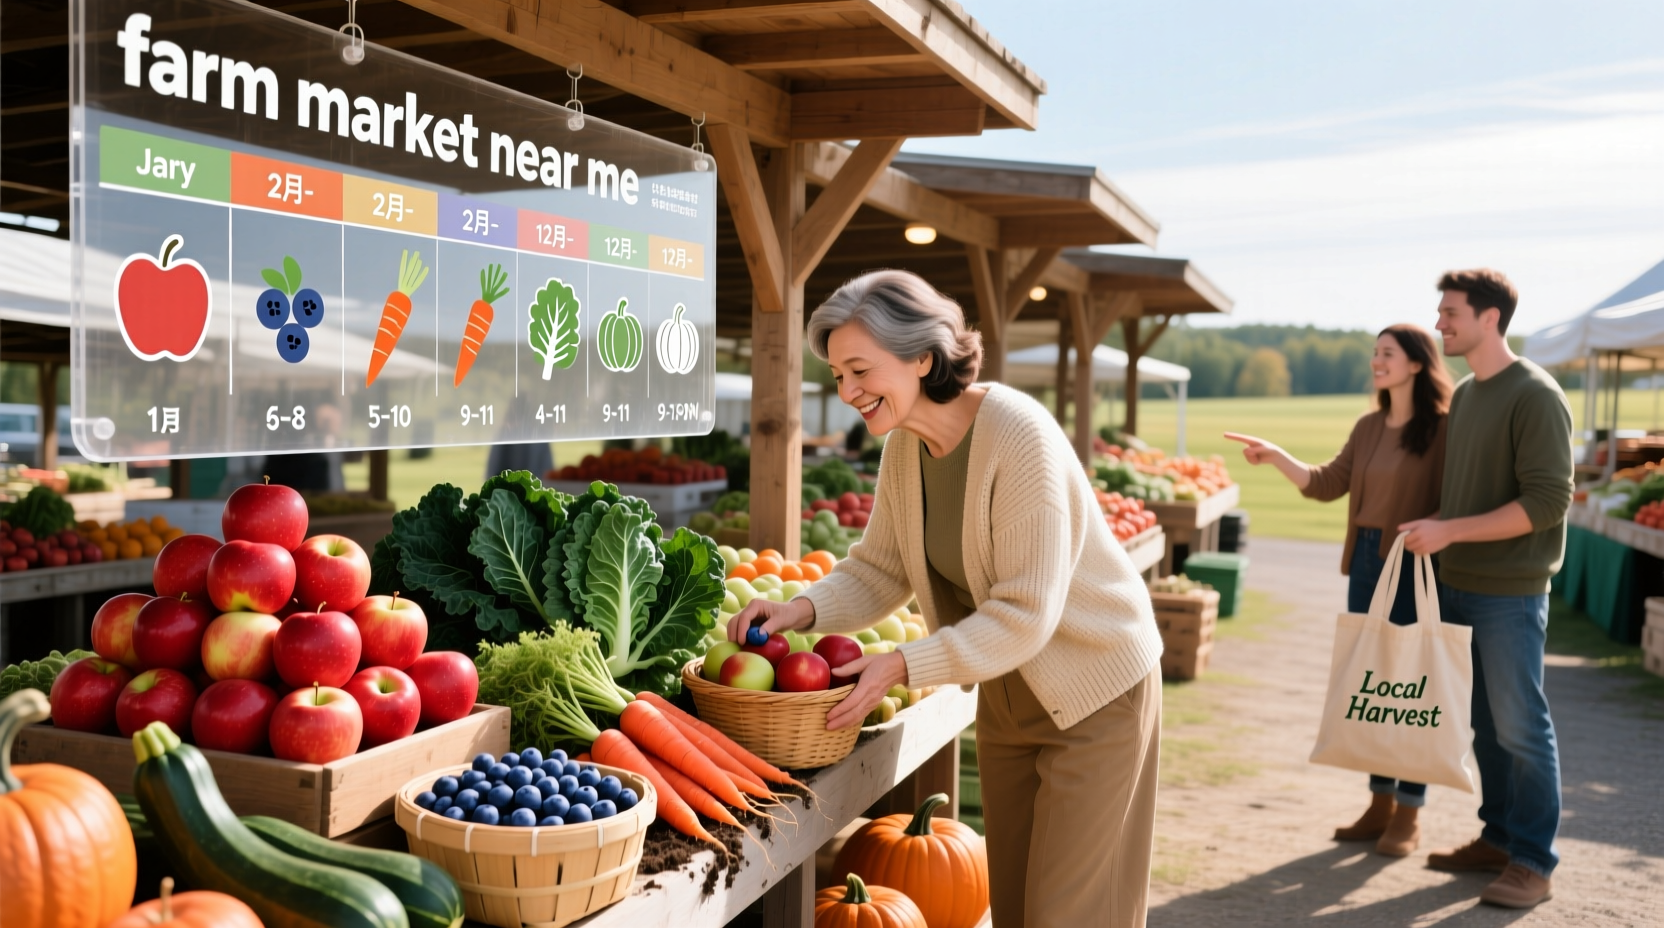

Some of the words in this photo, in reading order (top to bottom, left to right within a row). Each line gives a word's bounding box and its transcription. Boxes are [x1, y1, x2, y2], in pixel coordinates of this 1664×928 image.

[117, 13, 279, 120] farm
[298, 79, 479, 168] market
[490, 132, 579, 192] near
[587, 158, 640, 206] me
[135, 148, 196, 189] Jary
[266, 172, 314, 205] 2月-
[372, 192, 414, 222] 2月-
[462, 208, 499, 236] 2月-
[536, 223, 574, 249] 12月-
[604, 237, 638, 260] 12月-
[662, 247, 693, 269] 12月-
[147, 406, 180, 434] 1月
[266, 405, 306, 431] 6-8
[368, 404, 412, 429] 5-10
[460, 404, 494, 427] 9-11
[535, 403, 566, 424] 4-11
[602, 403, 630, 423] 9-11
[1359, 670, 1428, 699] Local
[1345, 695, 1442, 728] Harvest
